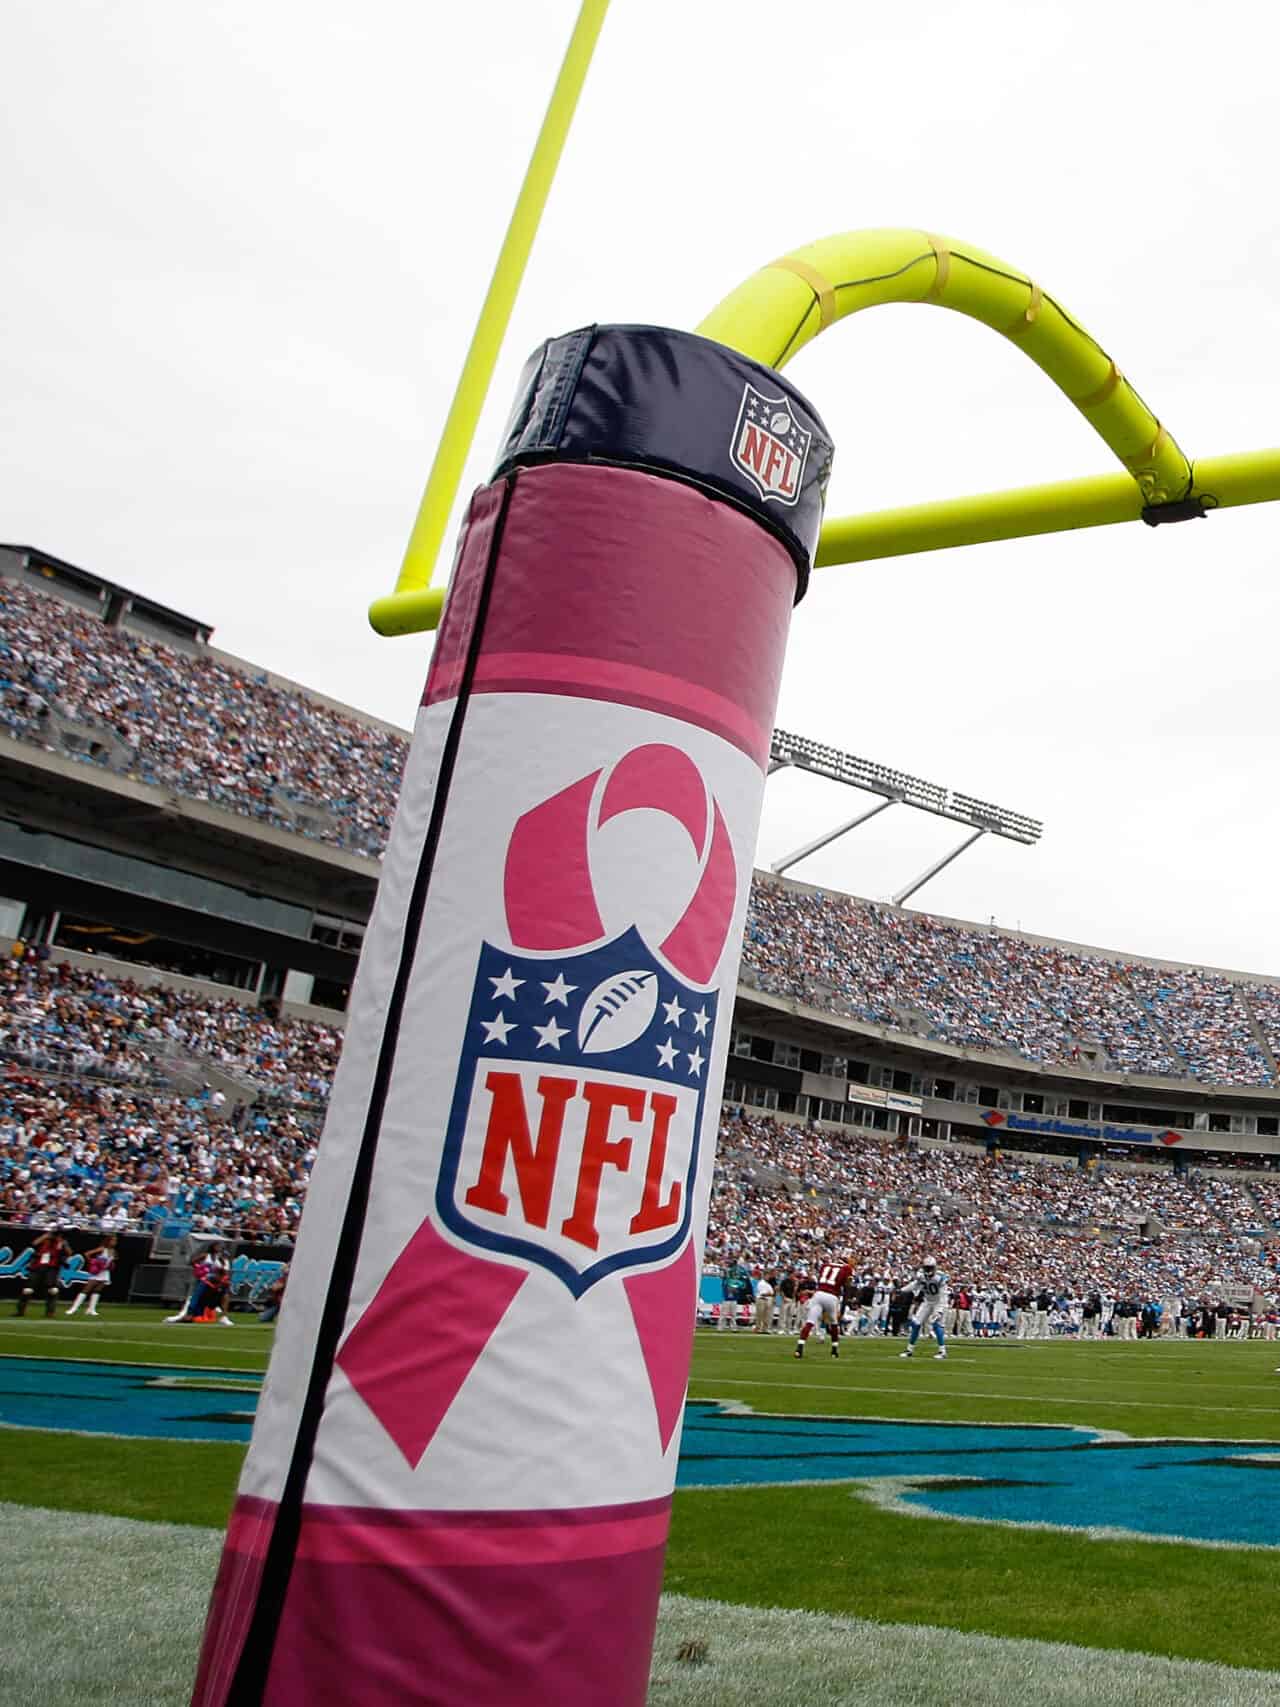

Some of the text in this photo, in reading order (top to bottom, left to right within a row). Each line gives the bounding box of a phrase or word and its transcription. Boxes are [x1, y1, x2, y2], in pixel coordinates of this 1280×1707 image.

[740, 420, 795, 494] NFL
[464, 1071, 682, 1252] NFL
[819, 1265, 841, 1285] 11
